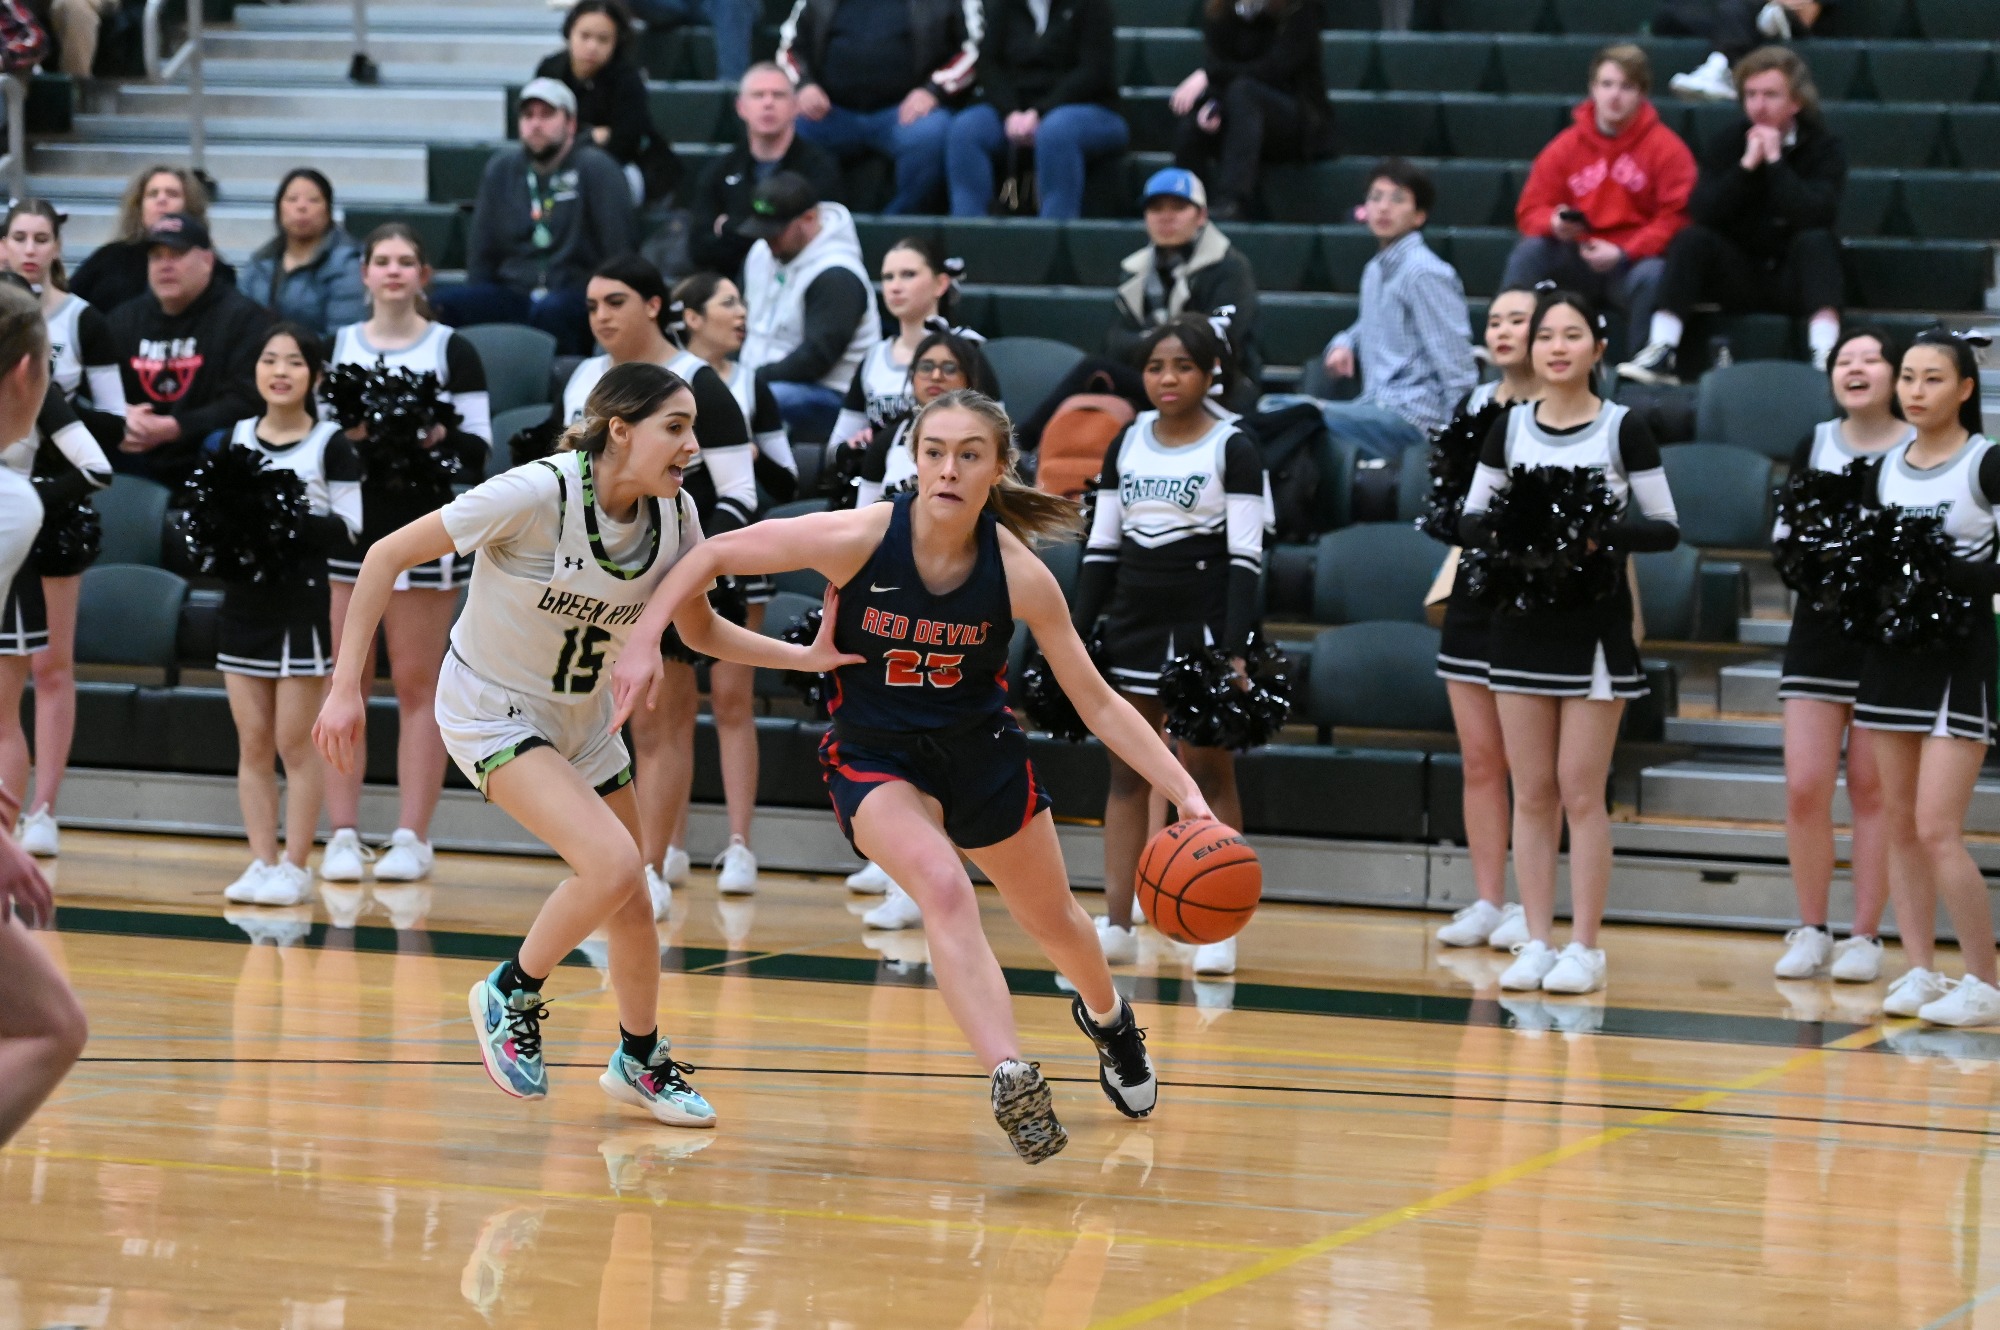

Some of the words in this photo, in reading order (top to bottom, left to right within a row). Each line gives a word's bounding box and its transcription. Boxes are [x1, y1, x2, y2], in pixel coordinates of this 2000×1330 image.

[1120, 471, 1211, 512] GATORS
[537, 587, 609, 623] GREEN
[603, 602, 646, 625] RIV
[862, 606, 909, 640] RED
[552, 624, 611, 694] 15
[883, 649, 964, 688] 25
[1192, 837, 1248, 860] ELITE
